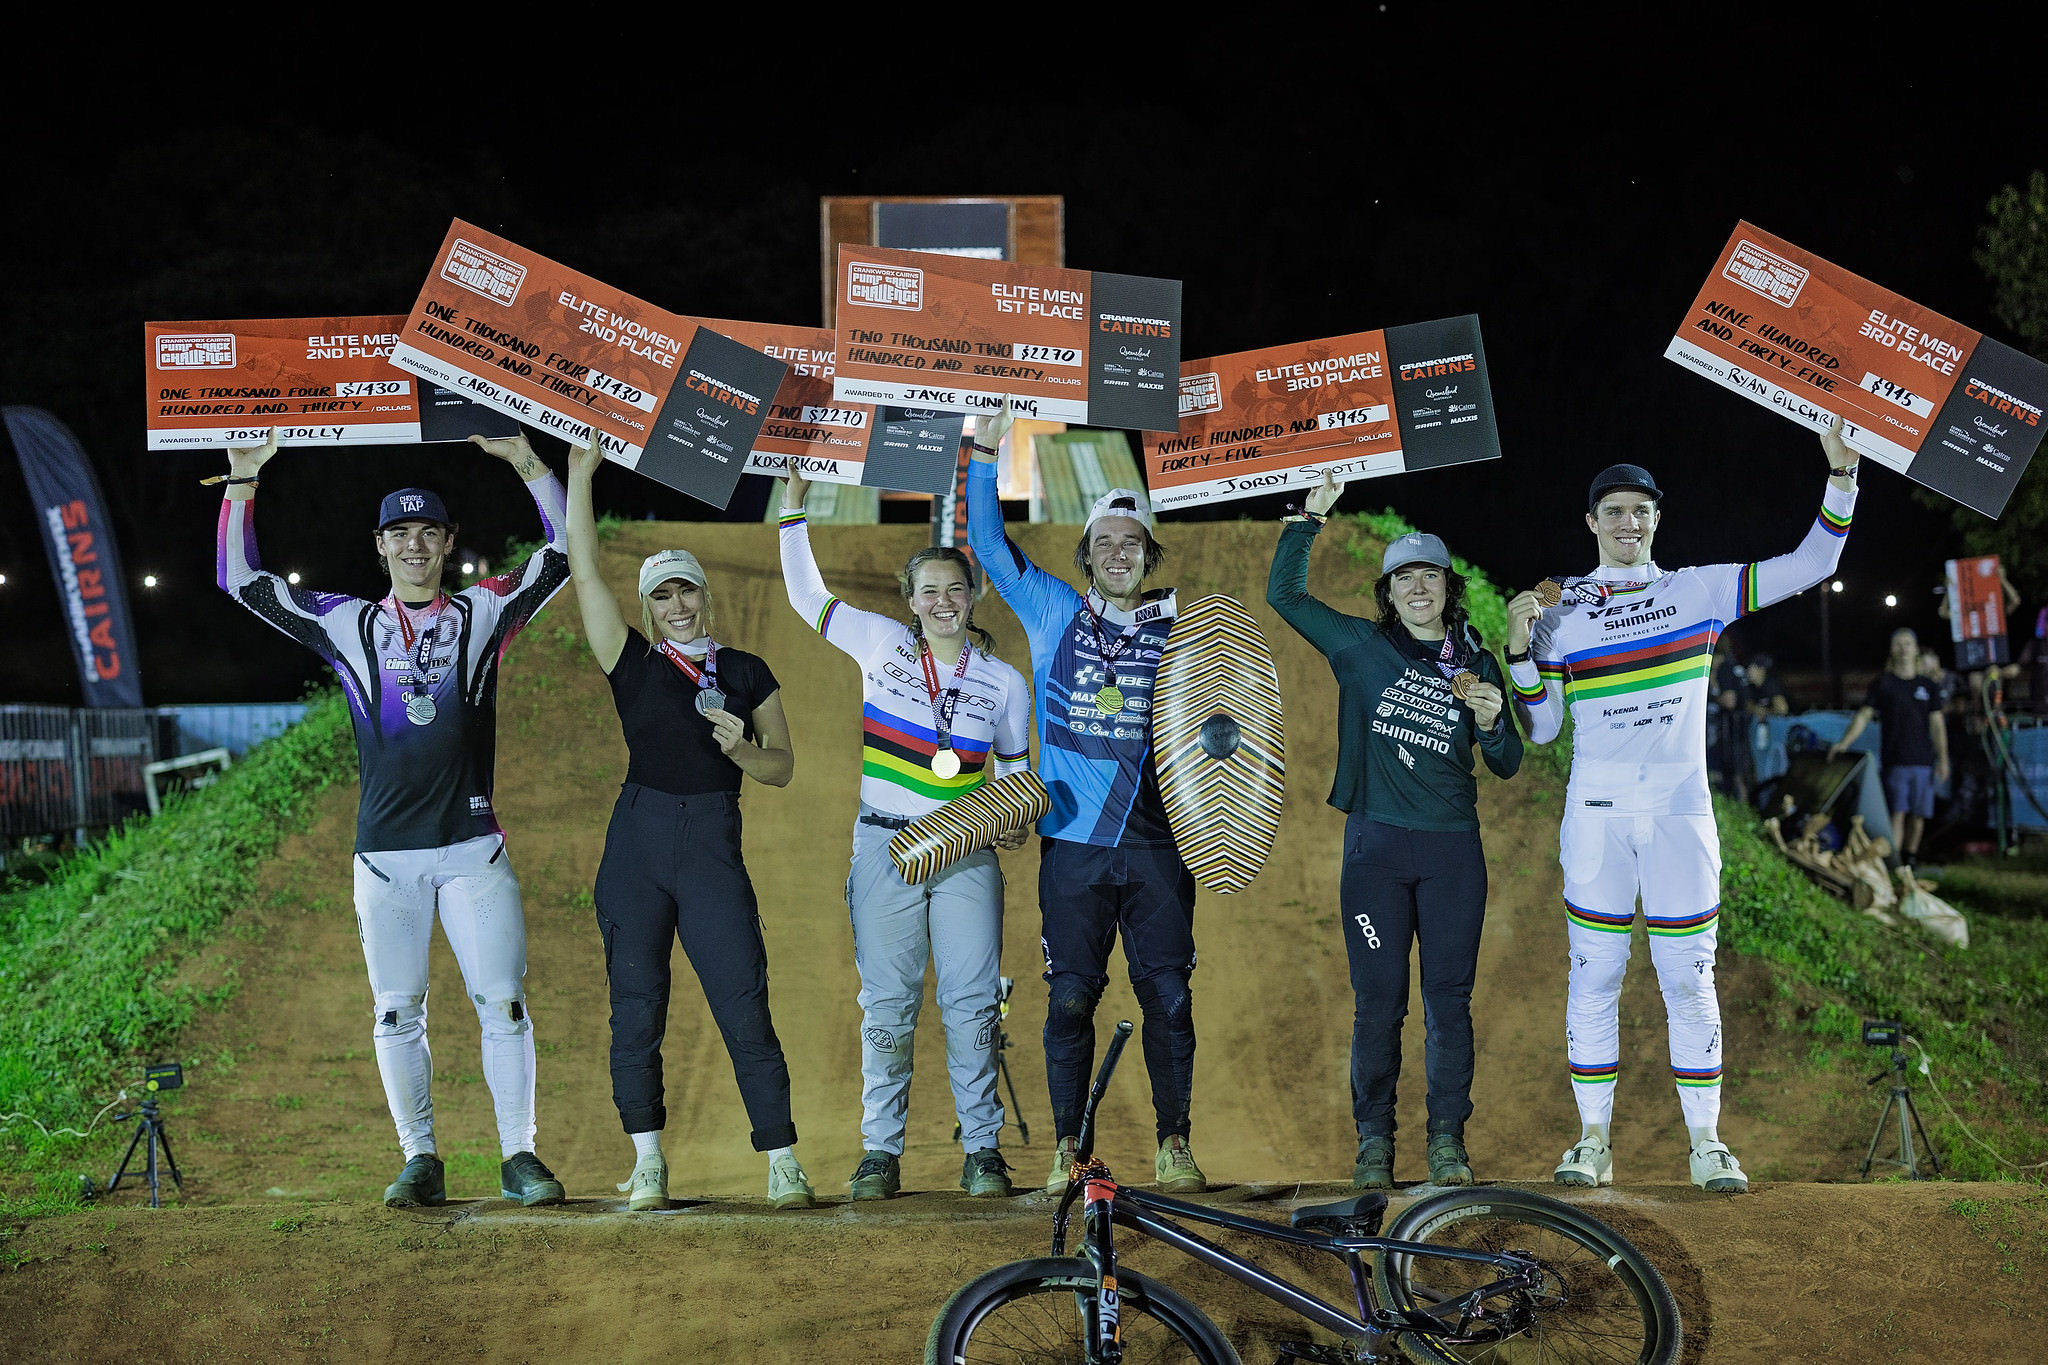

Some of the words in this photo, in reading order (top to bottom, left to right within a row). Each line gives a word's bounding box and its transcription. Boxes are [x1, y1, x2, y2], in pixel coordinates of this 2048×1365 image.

[453, 250, 485, 268] PUMP
[458, 244, 499, 266] CRANKWORX
[1736, 250, 1768, 270] PUMP
[1742, 246, 1780, 268] CRANKWORX
[448, 260, 514, 299] CHALLENGE
[852, 273, 883, 284] PUMP
[853, 267, 896, 276] CRANKWORX
[1730, 260, 1796, 300] CHALLENGE
[852, 284, 919, 304] CHALLENGE
[991, 284, 1040, 300] ELITE
[1044, 289, 1084, 305] MEN
[996, 300, 1025, 314] 1ST
[1028, 302, 1084, 320] PLACE
[1100, 314, 1171, 327] CRANKWORX
[558, 291, 609, 322] ELITE
[610, 312, 682, 354] WOMEN
[1100, 320, 1171, 338] CAIRNS
[1696, 318, 1733, 342] AND
[308, 335, 358, 347] ELITE
[578, 318, 617, 343] 2ND
[618, 336, 676, 369] PLACE
[850, 329, 884, 344] TWO
[891, 332, 972, 355] THOUSAND
[974, 344, 1013, 359] TWO
[1021, 344, 1076, 363] $2270
[1705, 300, 1752, 330] NINE
[1758, 323, 1840, 370] HUNDRED
[1868, 309, 1919, 341] ELITE
[1920, 332, 1963, 363] MEN
[161, 350, 232, 366] CHALLENGE
[306, 348, 350, 360] 2ND
[352, 346, 395, 359] PLAC
[425, 300, 460, 324] ONE
[464, 317, 541, 360] THOUSAND
[544, 352, 590, 383] FOUR
[592, 373, 642, 404] $1430
[763, 345, 810, 362] ELITE
[1858, 322, 1898, 350] 3RD
[1897, 342, 1957, 377] PLACE
[401, 356, 439, 378] AWARDED
[440, 372, 450, 382] TO
[417, 320, 494, 362] HUNDRED
[497, 355, 533, 377] AND
[540, 371, 598, 406] THIRTY
[793, 364, 820, 377] 1ST
[848, 348, 926, 370] HUNDRED
[933, 358, 963, 372] AND
[973, 364, 1045, 382] SEVENTY
[1255, 364, 1302, 383] ELITE
[1306, 351, 1380, 375] WOMEN
[1400, 353, 1474, 371] CRANKWORX
[1400, 360, 1476, 382] CAIRNS
[1677, 350, 1713, 371] AWARDED
[1714, 367, 1724, 376] TO
[688, 369, 762, 406] CRANKWORX
[1138, 382, 1164, 390] MAXXIS
[1286, 375, 1323, 392] 3RD
[1326, 365, 1383, 386] PLACE
[160, 387, 192, 400] ONE
[198, 386, 281, 399] THOUSAND
[288, 386, 332, 398] FOUR
[342, 382, 400, 398] $1430
[458, 376, 532, 416] CAROLINE
[685, 376, 759, 416] CAIRNS
[844, 389, 882, 399] AWARDED
[883, 392, 894, 400] TO
[904, 389, 956, 405] JAYCE
[1872, 378, 1919, 407] $945
[1969, 377, 2044, 416] CRANKWORX
[160, 403, 245, 416] HUNDRED
[251, 402, 289, 415] AND
[299, 401, 364, 414] THIRTY
[1727, 368, 1768, 396] RYAN
[1773, 390, 1860, 438] GILCHRIT
[1964, 384, 2040, 427] CAIRNS
[768, 404, 802, 420] TWO
[808, 404, 864, 426] $2270
[1450, 414, 1478, 425] MAXXIS
[225, 430, 271, 441] JOSH
[284, 427, 345, 440] JOLLY
[766, 425, 832, 444] SEVENTY
[1158, 435, 1202, 455] NINE
[1210, 424, 1284, 446] HUNDRED
[1289, 418, 1318, 432] AND
[1327, 408, 1372, 428] $945
[700, 448, 729, 464] MAXXIS
[916, 444, 943, 452] MAXXIS
[1976, 456, 2006, 473] MAXXIS
[1217, 472, 1289, 495] JORDY
[400, 500, 424, 512] TAP
[1160, 493, 1198, 504] AWARDED
[1199, 491, 1210, 499] TO
[60, 499, 120, 680] CAIRNS
[1574, 586, 1600, 605] 2025
[1586, 597, 1655, 620] YETI
[1604, 605, 1678, 631] SHIMANO
[1600, 633, 1630, 642] FACTORY
[1652, 624, 1670, 632] TEAM
[420, 637, 432, 664] 2025
[899, 648, 918, 665] UCI
[954, 646, 969, 678] CAIRNS
[1394, 678, 1454, 704] KENDA
[1128, 700, 1148, 708] BELL
[1612, 706, 1639, 716] KENDA
[1372, 720, 1450, 755] SHIMANO
[1354, 913, 1381, 950] POC
